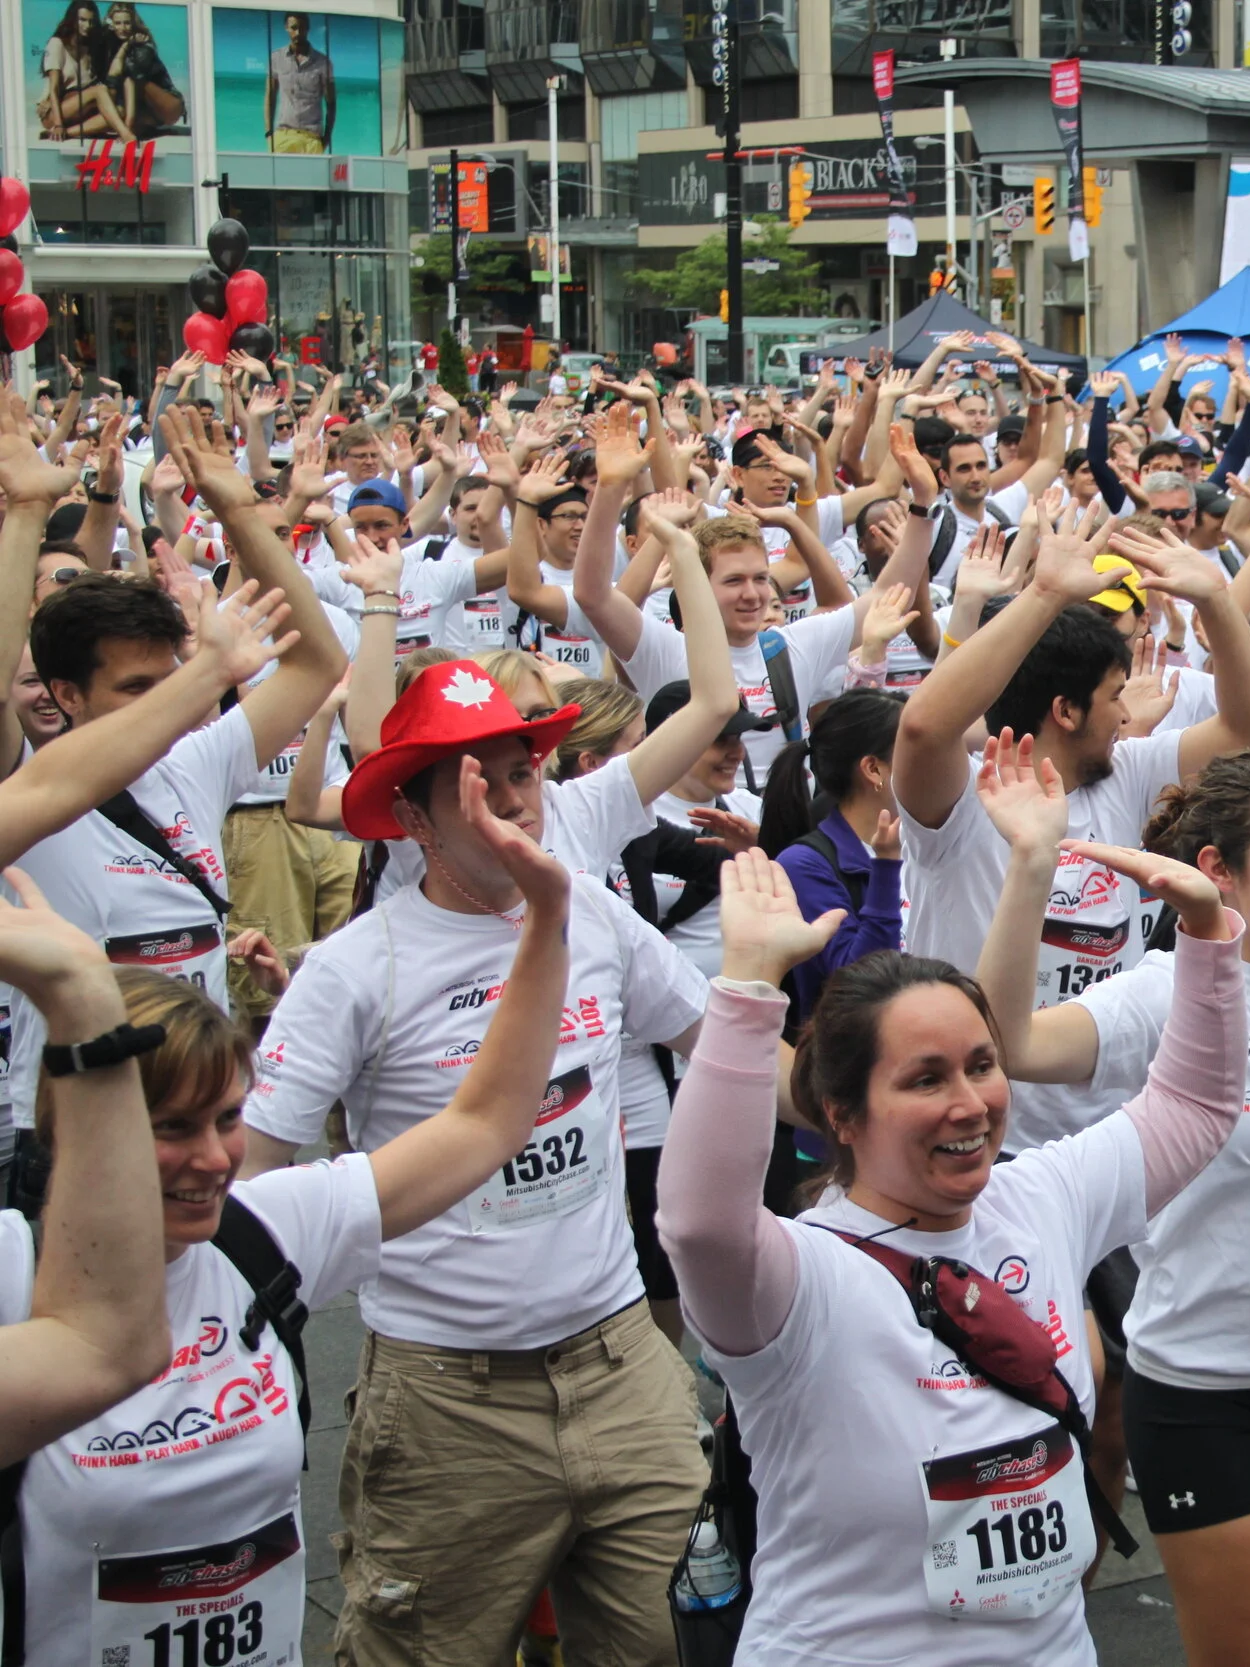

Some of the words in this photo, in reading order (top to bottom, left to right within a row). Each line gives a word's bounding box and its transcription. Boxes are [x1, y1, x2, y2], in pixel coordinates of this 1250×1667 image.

[75, 139, 156, 193] H&M
[556, 646, 590, 662] 1260
[103, 864, 127, 874] THINK
[578, 995, 606, 1039] 2011
[434, 1057, 464, 1070] THINK
[502, 1126, 588, 1187] 1532
[506, 1165, 591, 1198] MitsubishiCityChase.com
[252, 1353, 289, 1416] 2011
[72, 1452, 107, 1469] THINK
[146, 1446, 170, 1462] PLAY
[205, 1426, 239, 1446] LAUGH
[990, 1500, 1009, 1513] THE
[1010, 1490, 1048, 1509] SPECIALS
[966, 1499, 1068, 1571] 1183
[976, 1551, 1074, 1586] MitsubishiCityChase.com
[175, 1603, 197, 1618] THE
[199, 1592, 245, 1615] SPECIALS
[143, 1600, 263, 1667] 1183
